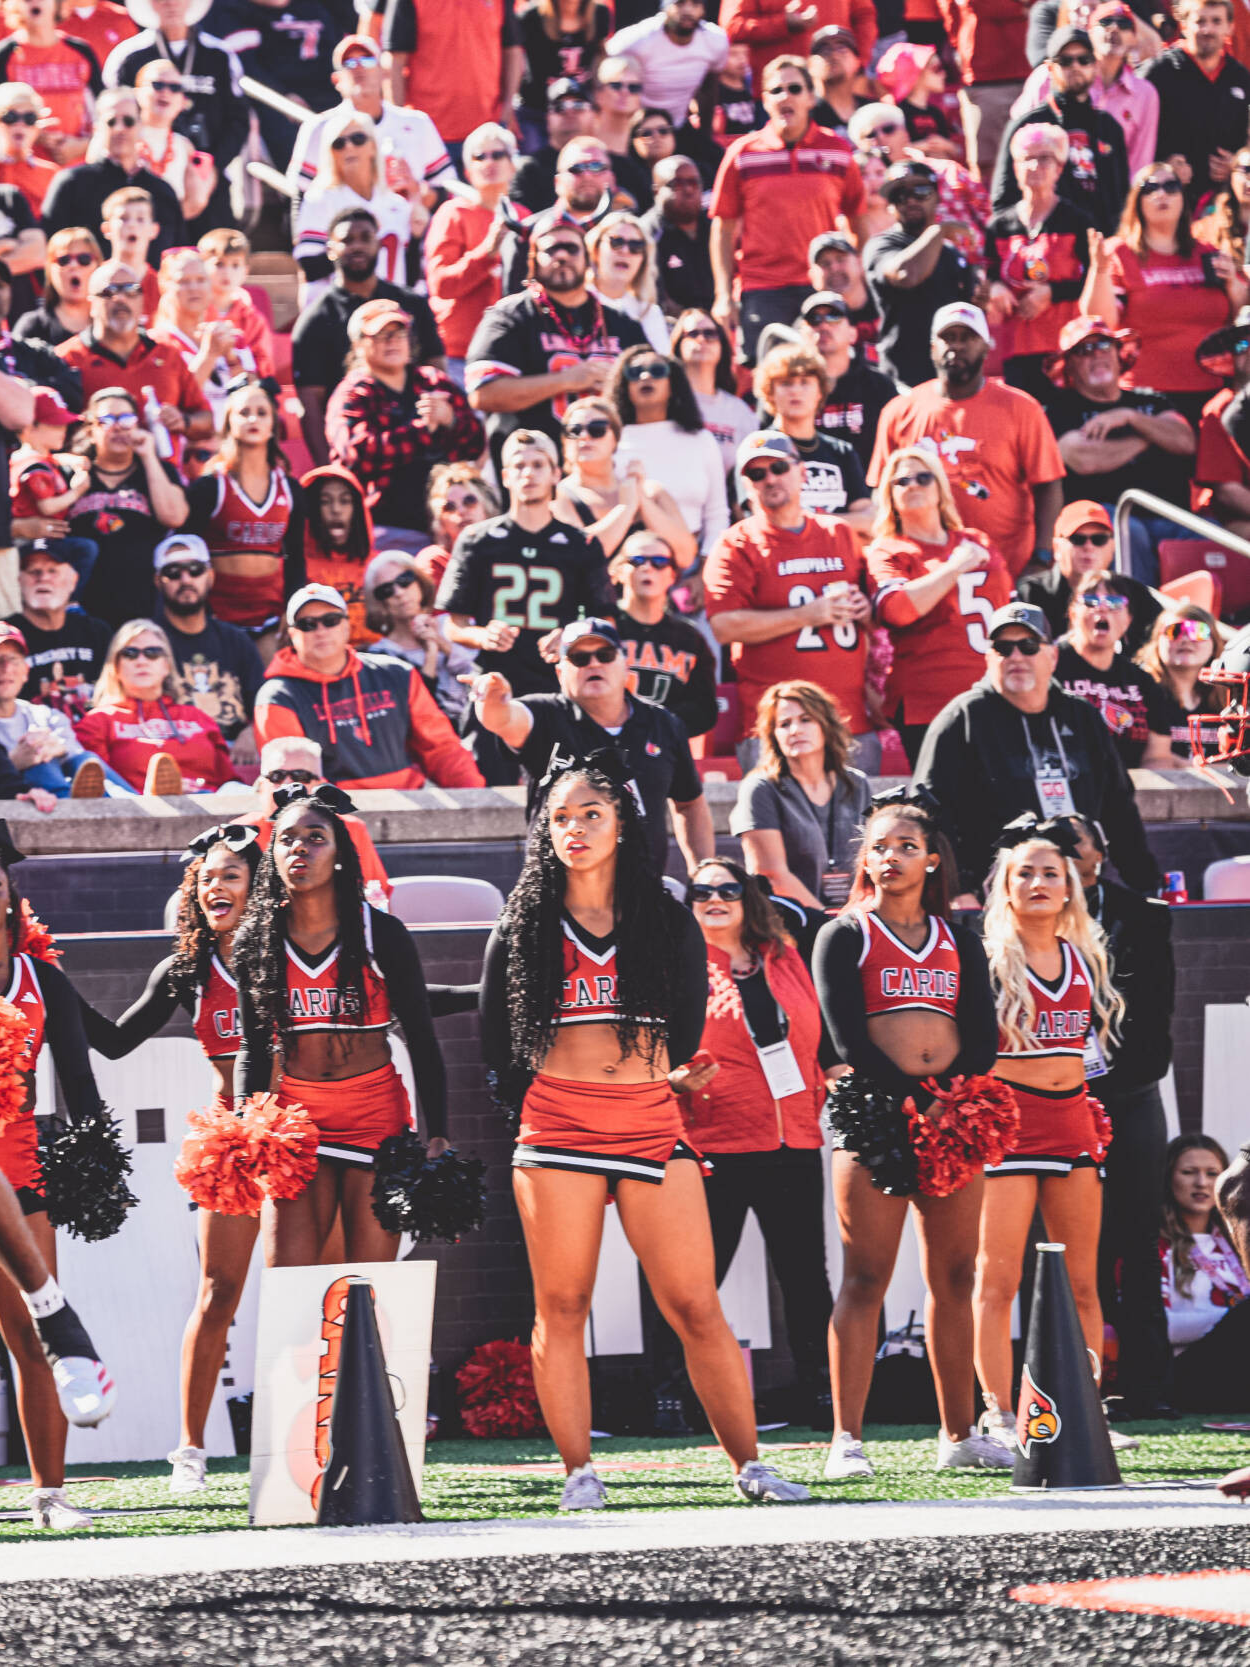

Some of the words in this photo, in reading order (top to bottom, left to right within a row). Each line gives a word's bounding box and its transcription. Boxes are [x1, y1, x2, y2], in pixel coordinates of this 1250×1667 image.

[778, 557, 844, 576] LOUISVILLE
[493, 564, 563, 630] 22
[957, 570, 999, 655] 5
[559, 975, 623, 1009] CAR
[880, 966, 957, 999] CARDS
[287, 987, 360, 1018] ARDS
[1025, 1010, 1088, 1038] ARDS
